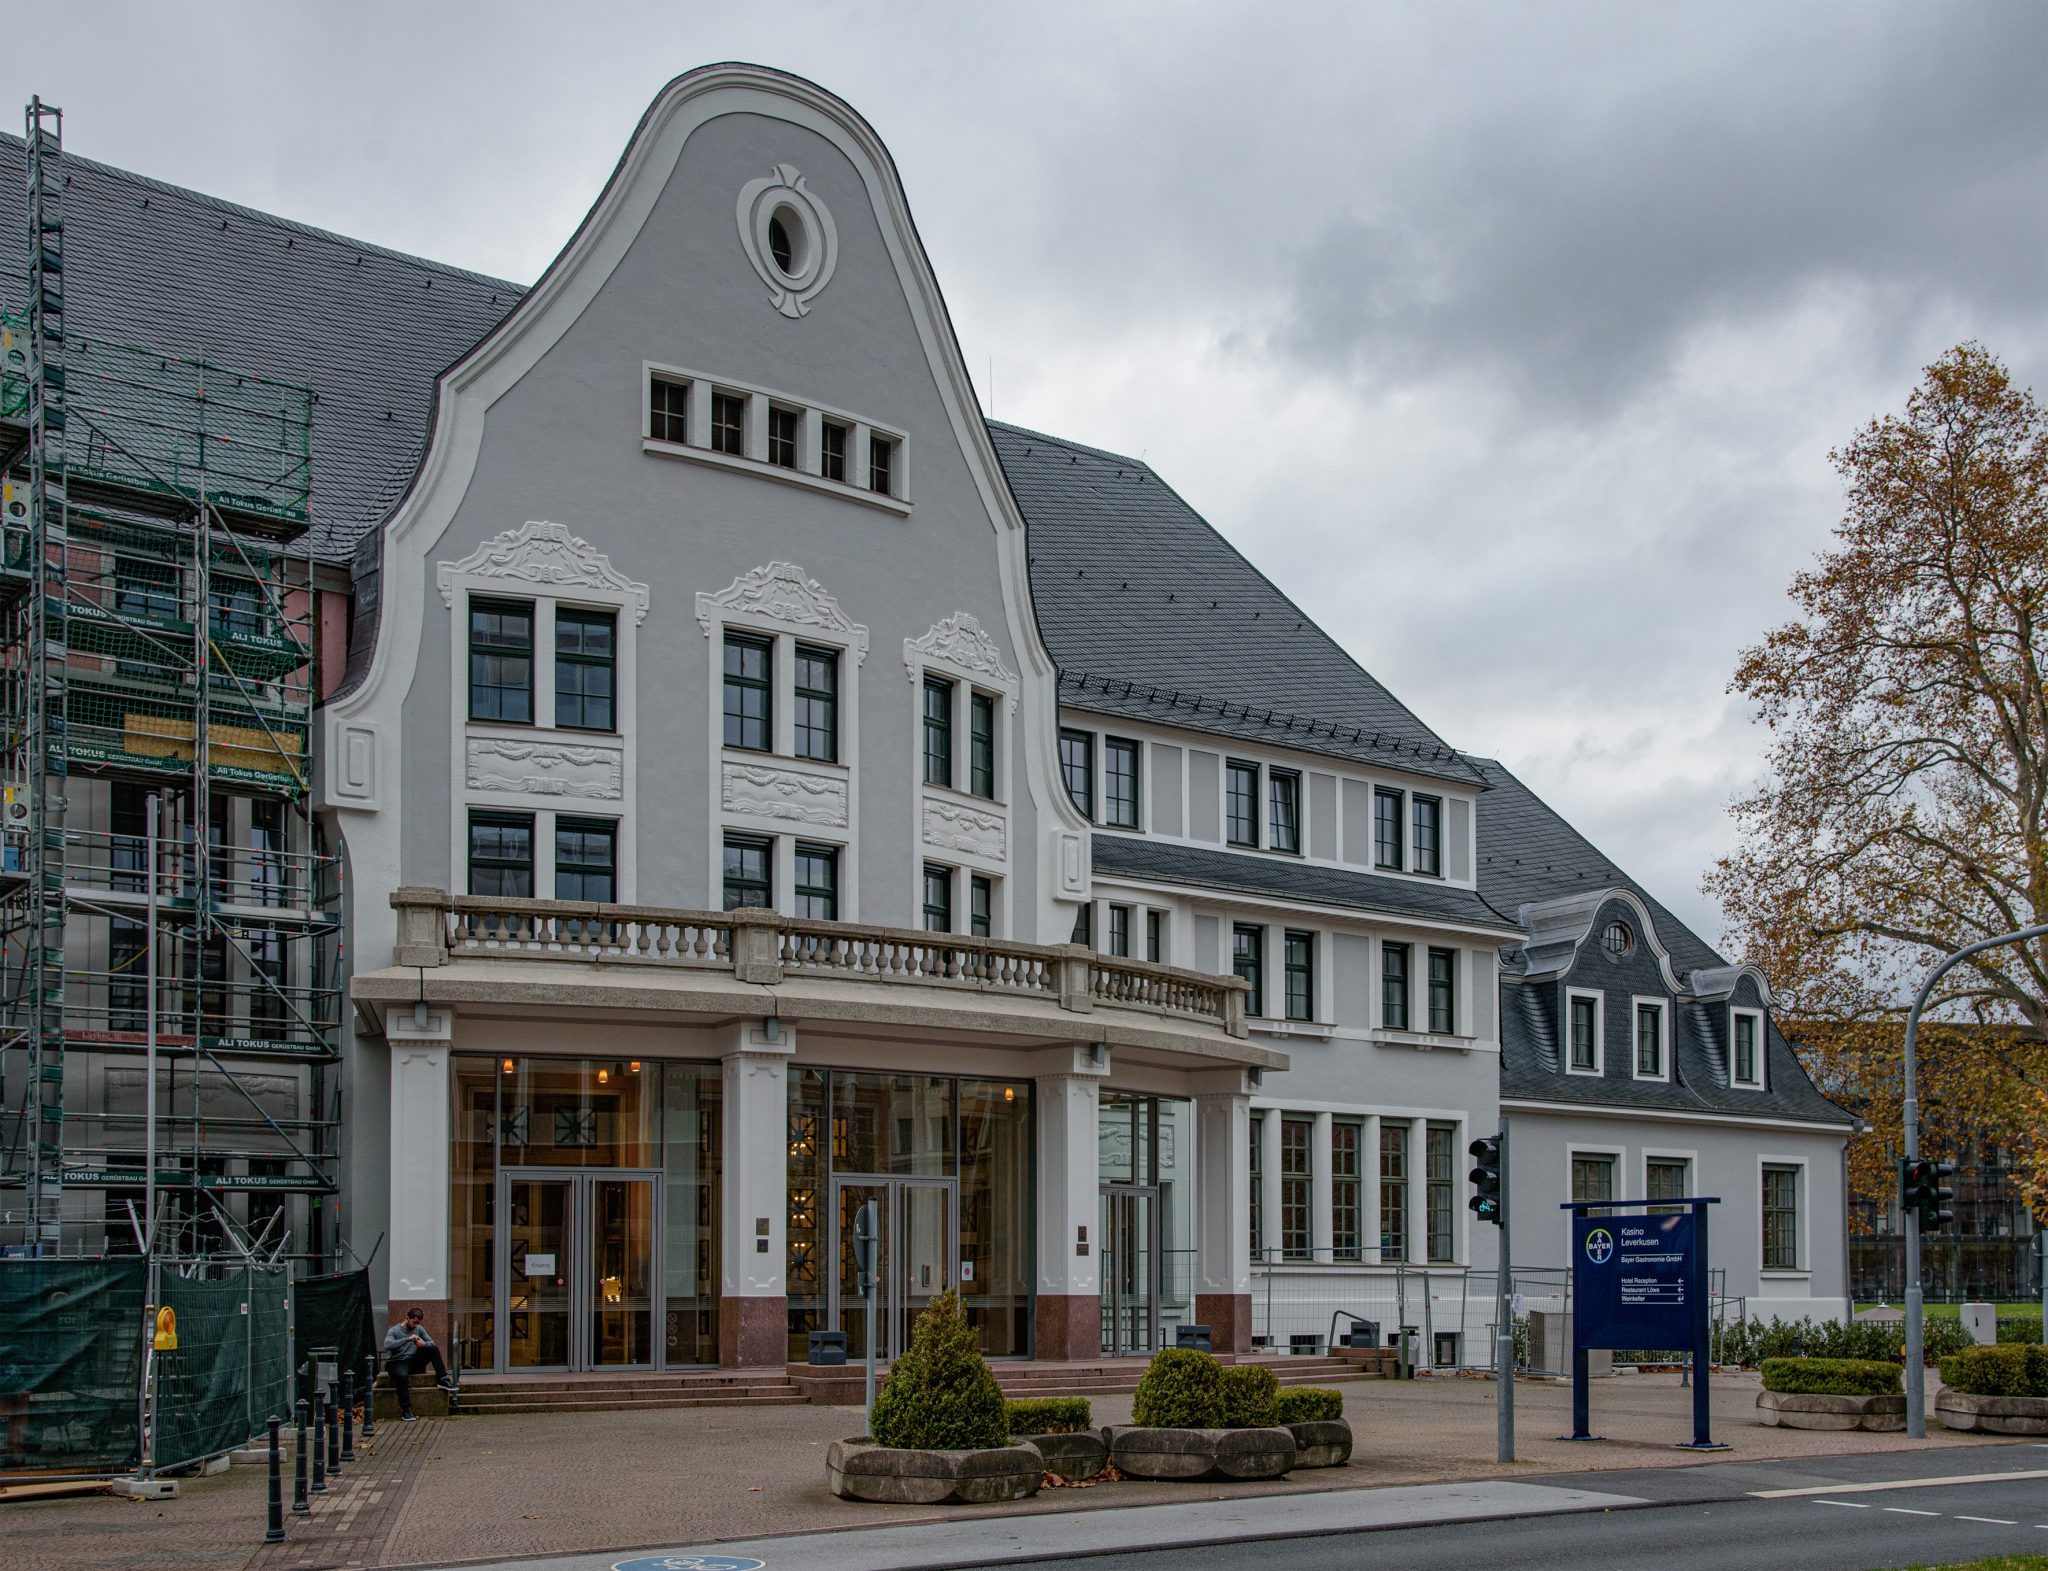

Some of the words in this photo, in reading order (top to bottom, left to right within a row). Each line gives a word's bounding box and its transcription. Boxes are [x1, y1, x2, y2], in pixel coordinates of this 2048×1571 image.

[232, 498, 255, 509] Tokus
[256, 502, 296, 517] Gerüstau
[70, 605, 107, 618] TOKUS
[146, 619, 164, 628] GmbH
[232, 632, 248, 641] ALI
[250, 635, 283, 648] TOKUS
[48, 744, 64, 753] AL
[68, 746, 105, 758] TOKUS
[230, 768, 253, 778] Tokus
[237, 1040, 269, 1048] TOKUS
[271, 1043, 304, 1051] GERÜSTBAU
[64, 1172, 99, 1180] TOKUS
[1621, 1227, 1644, 1236] Kasino
[1621, 1238, 1659, 1246] Leverkusen
[1621, 1256, 1635, 1264] Bayer
